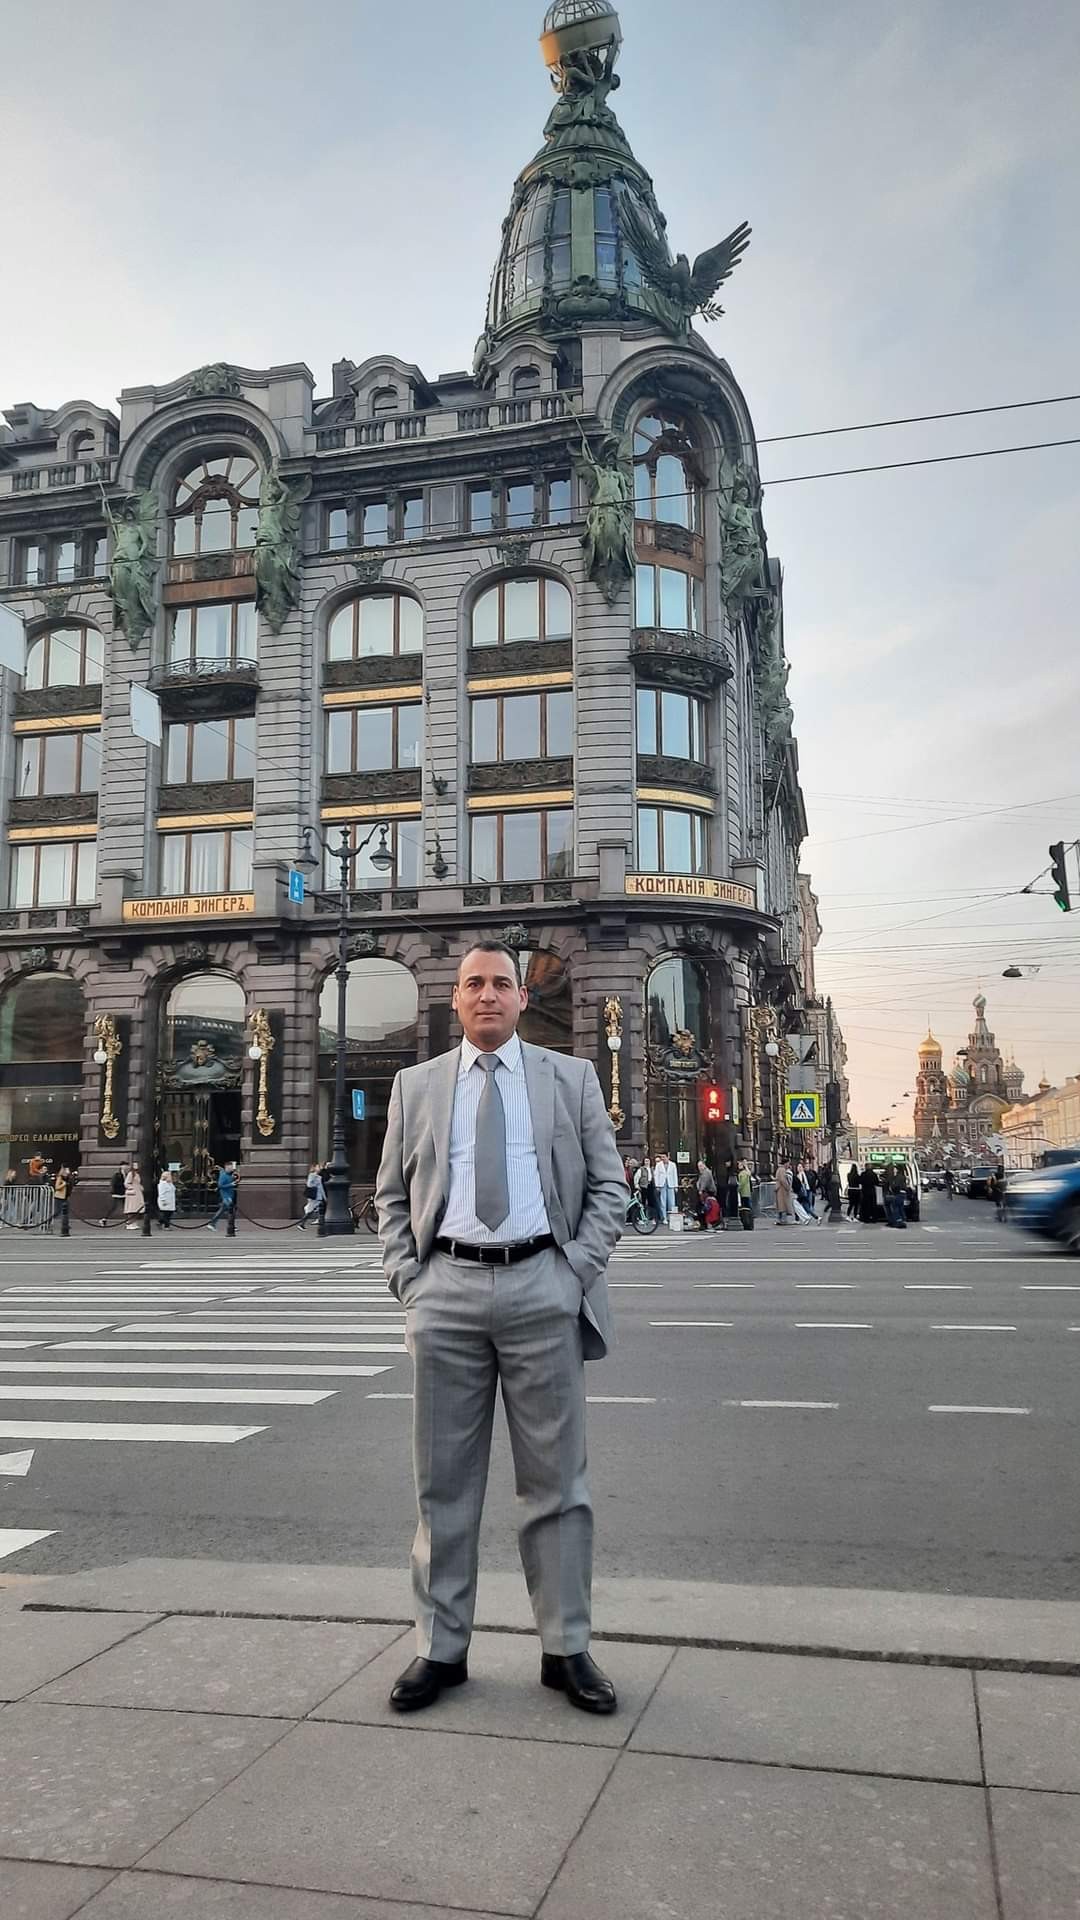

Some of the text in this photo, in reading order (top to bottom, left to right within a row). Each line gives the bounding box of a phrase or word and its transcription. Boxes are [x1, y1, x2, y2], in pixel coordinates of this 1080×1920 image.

[635, 878, 705, 896] КОМПАНІЯ
[132, 900, 189, 917] КОМПАНІЯ
[708, 1107, 720, 1119] 24
